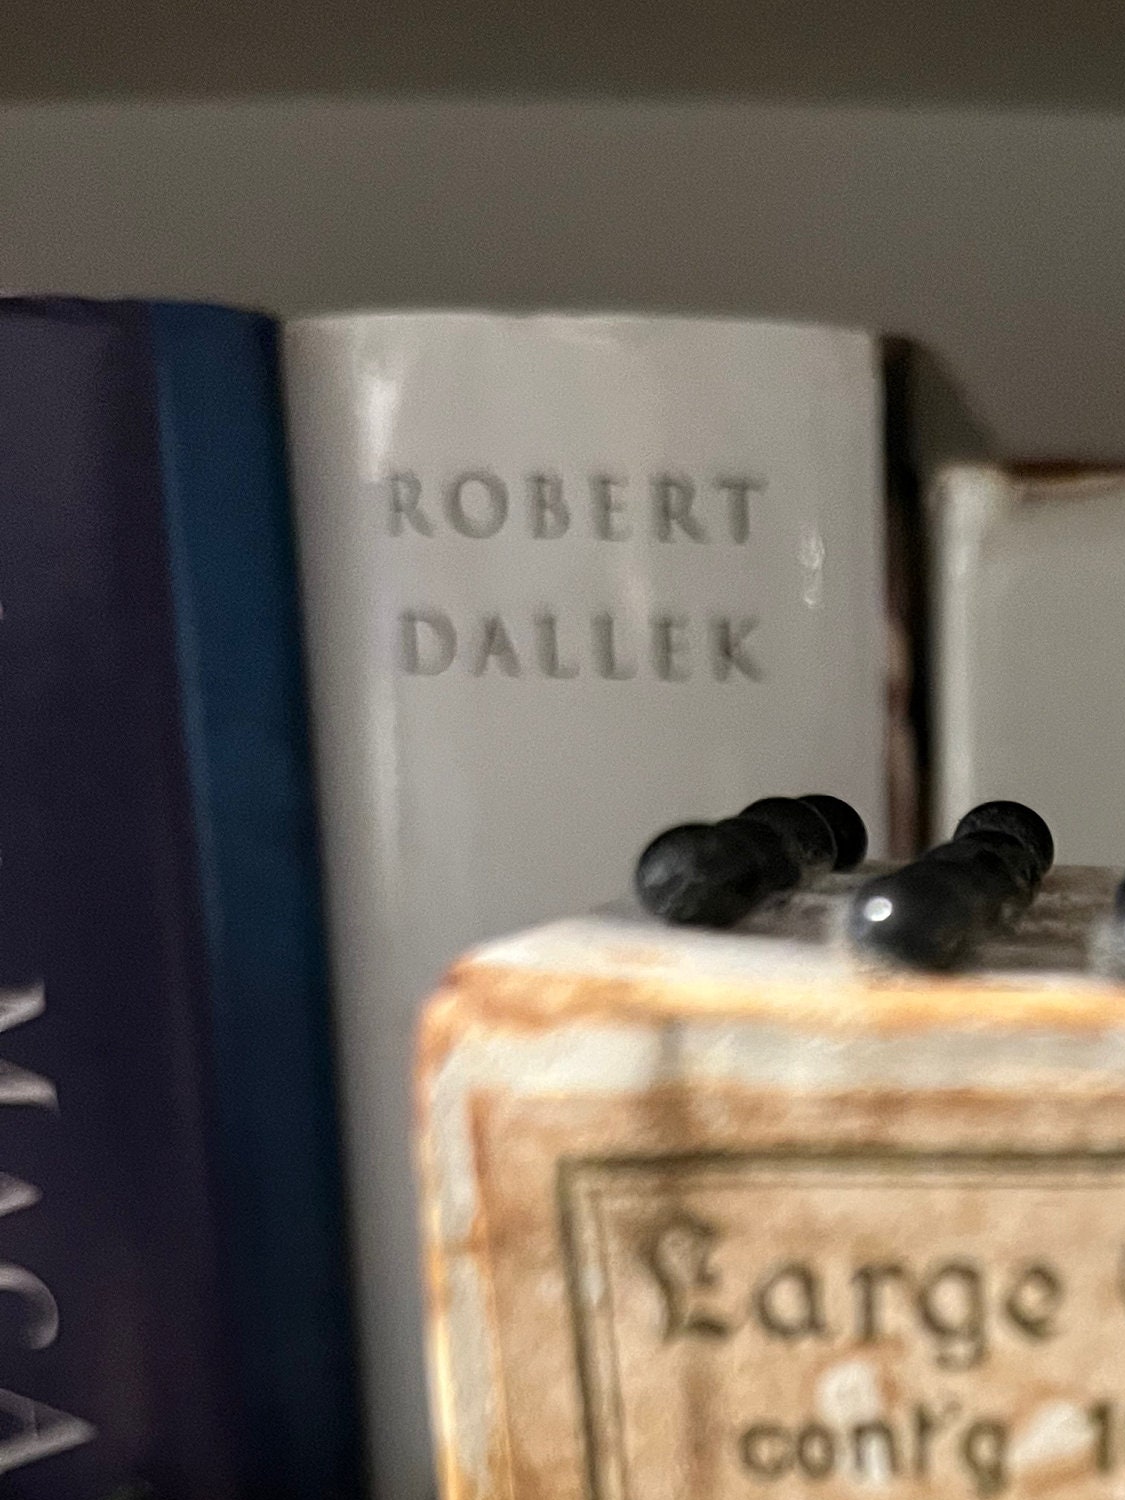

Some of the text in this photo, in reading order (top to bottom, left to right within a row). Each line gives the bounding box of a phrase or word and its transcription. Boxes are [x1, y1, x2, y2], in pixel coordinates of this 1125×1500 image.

[384, 466, 768, 546] ROBERT
[397, 609, 767, 683] DALLEK
[640, 1207, 1064, 1371] Large
